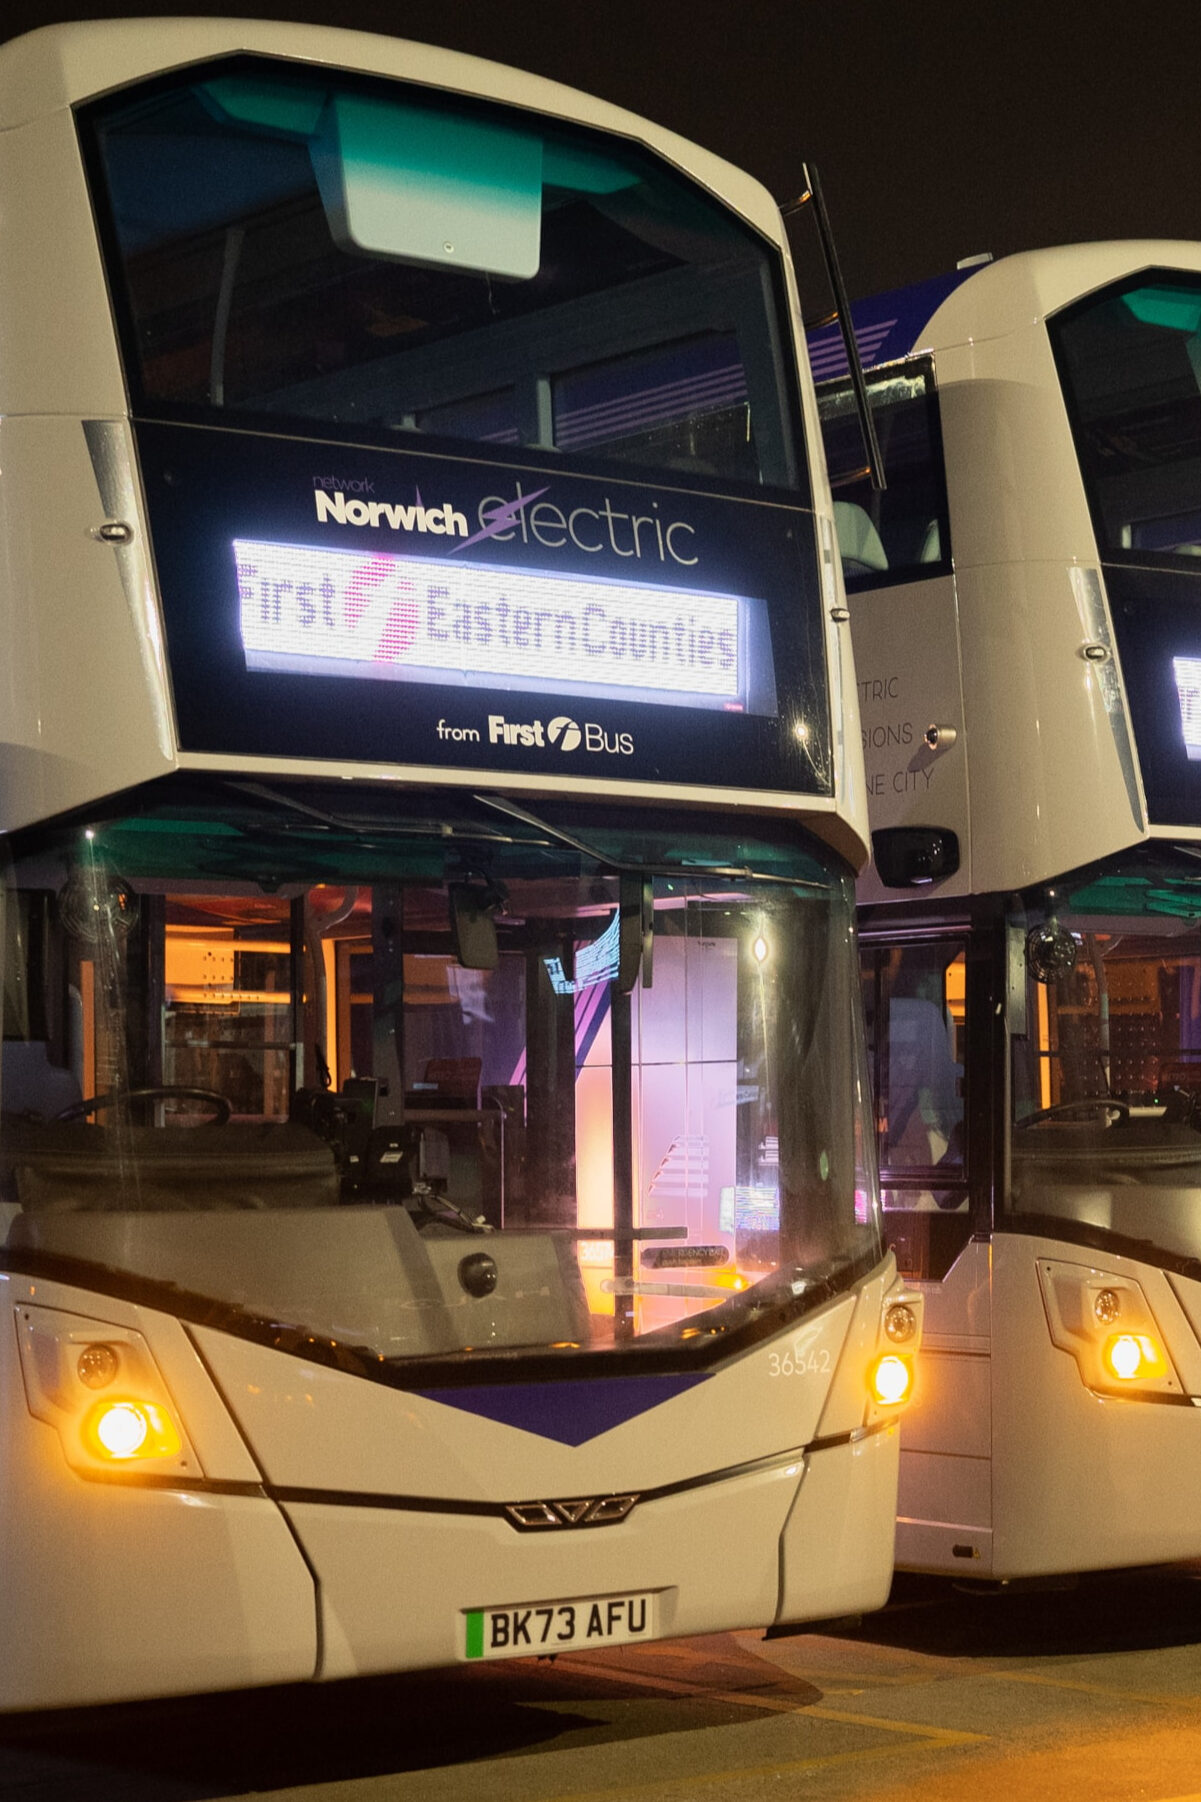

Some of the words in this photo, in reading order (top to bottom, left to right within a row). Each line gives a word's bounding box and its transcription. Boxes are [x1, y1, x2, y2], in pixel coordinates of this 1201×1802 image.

[313, 475, 375, 494] network
[314, 490, 469, 537] Norwich
[478, 482, 699, 566] electric
[857, 676, 899, 702] TRIC
[436, 718, 481, 744] from
[488, 715, 544, 748] First
[586, 725, 634, 756] Bus
[893, 768, 934, 793] CITY
[768, 1349, 831, 1377] 36542
[491, 1606, 576, 1649] BK73
[586, 1598, 647, 1639] AFU
